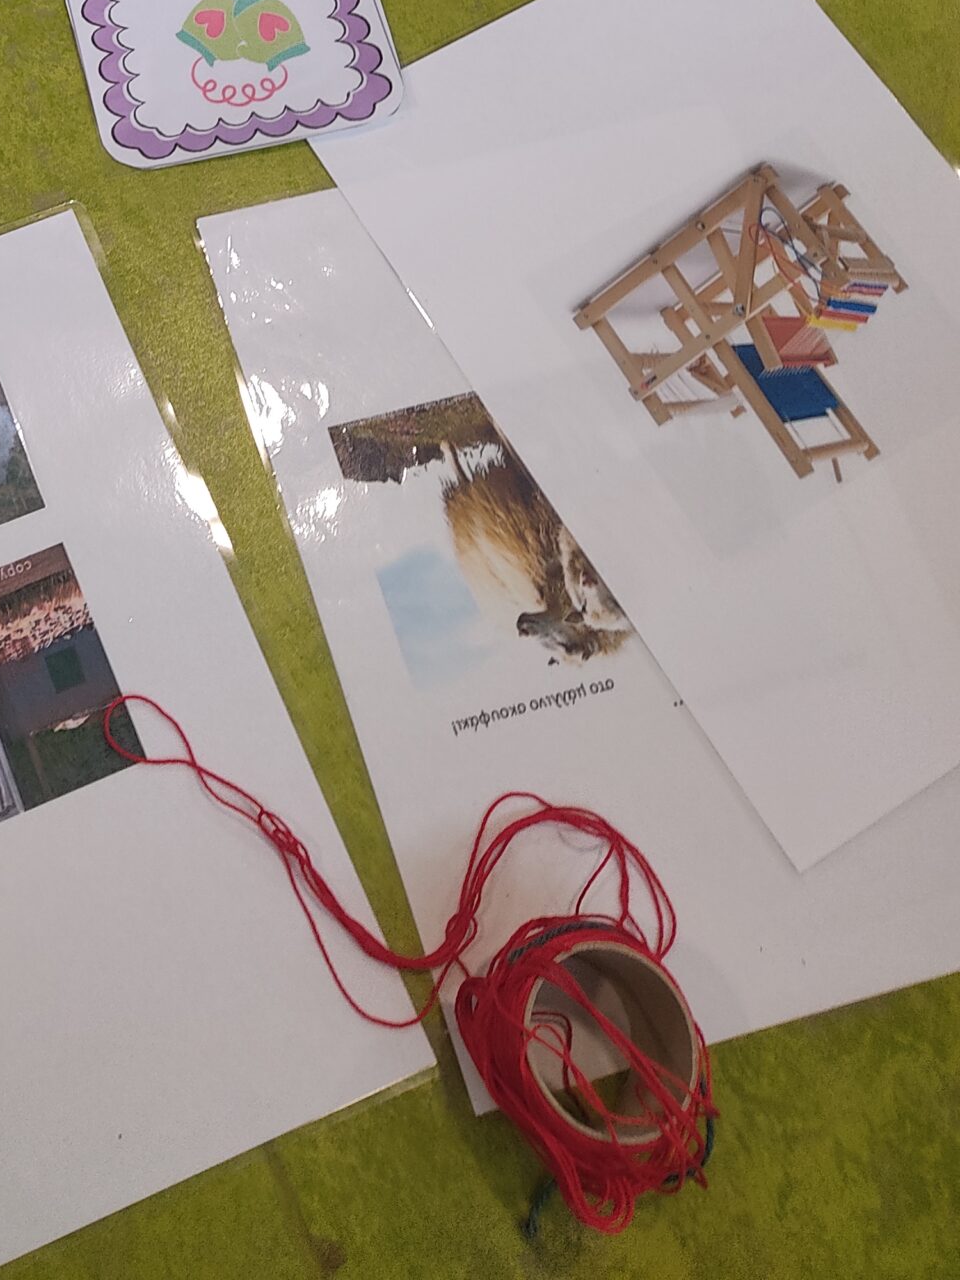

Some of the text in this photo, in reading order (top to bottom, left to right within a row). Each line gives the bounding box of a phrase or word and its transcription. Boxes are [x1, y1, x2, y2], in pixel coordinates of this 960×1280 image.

[451, 678, 615, 736] στο μάλλινο σκουφάκι!
